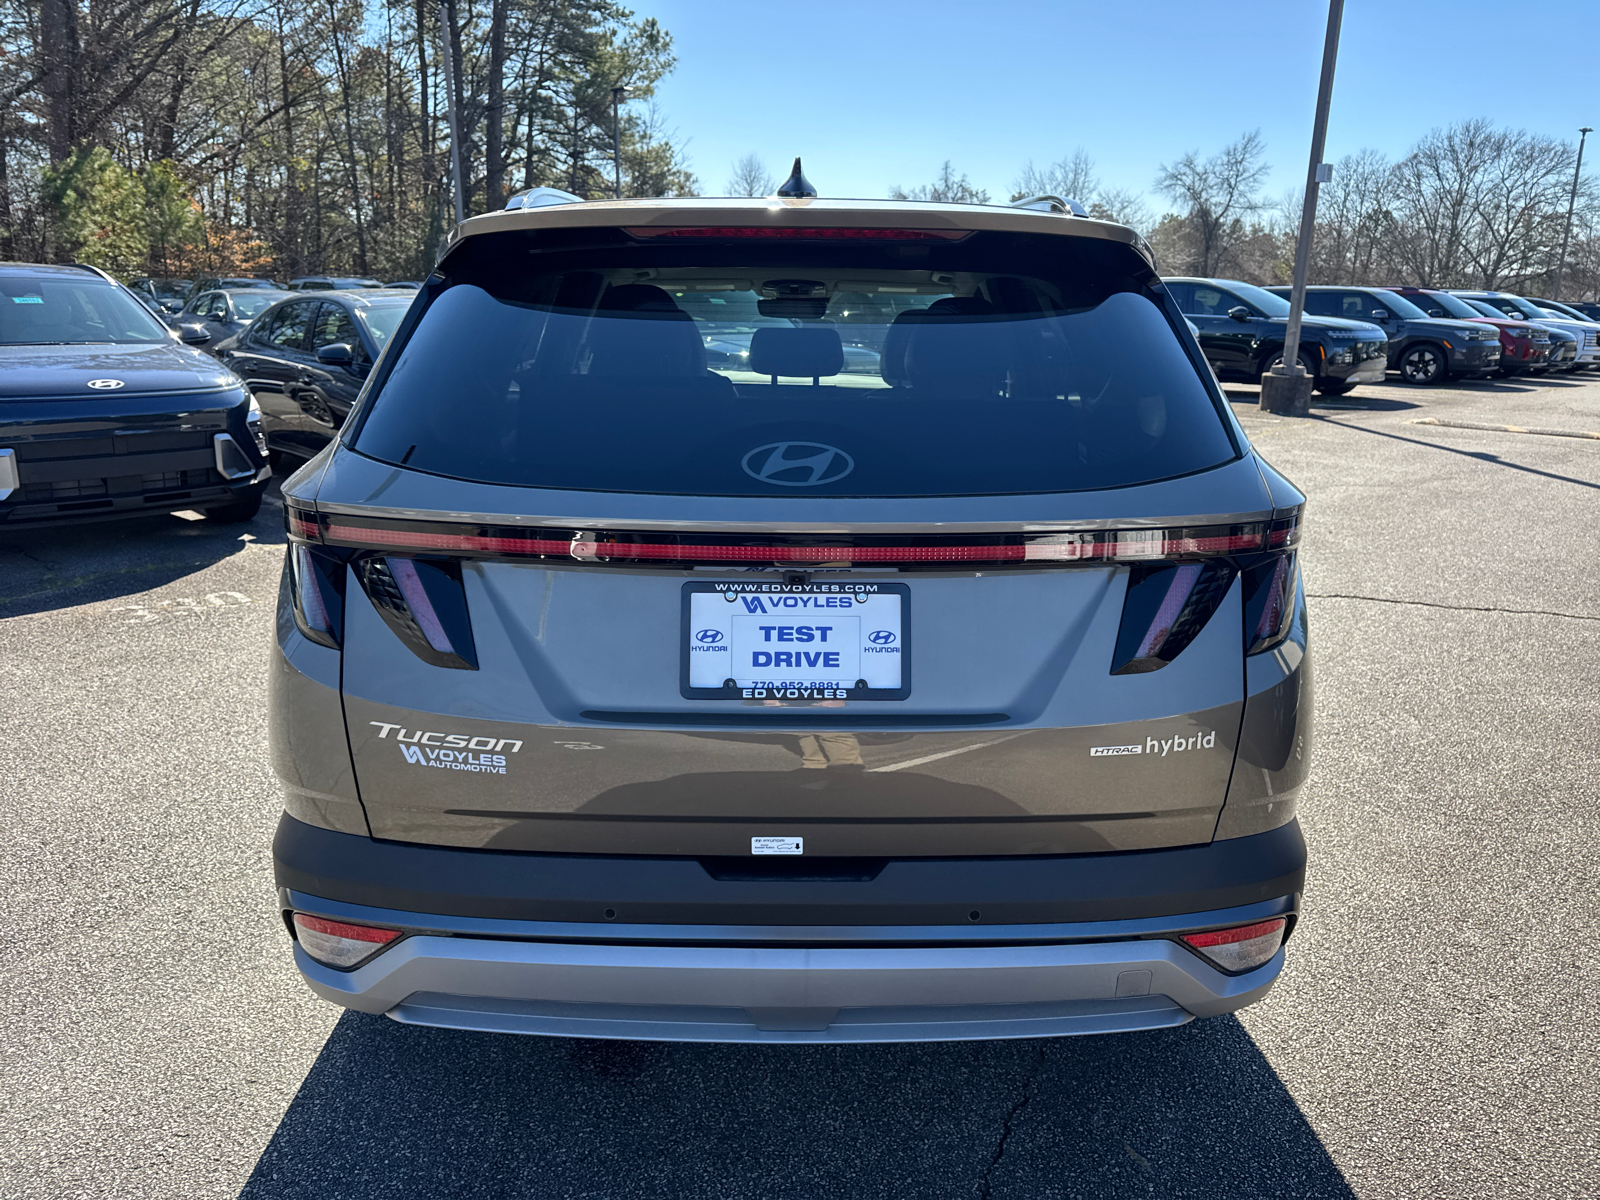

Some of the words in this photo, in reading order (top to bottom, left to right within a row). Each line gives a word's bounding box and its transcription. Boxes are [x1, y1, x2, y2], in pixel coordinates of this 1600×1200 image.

[715, 583, 878, 592] WWW.EDVOYLES.COM
[768, 596, 853, 608] VOYLES
[759, 626, 833, 642] TEST
[752, 651, 840, 668] DRIVE
[742, 689, 767, 699] ED
[773, 689, 848, 699] VOYLES
[1094, 747, 1139, 755] HTRAC
[1145, 730, 1216, 757] hybrid
[425, 747, 507, 767] VOYLES
[428, 760, 507, 775] AUTOMOTIVE
